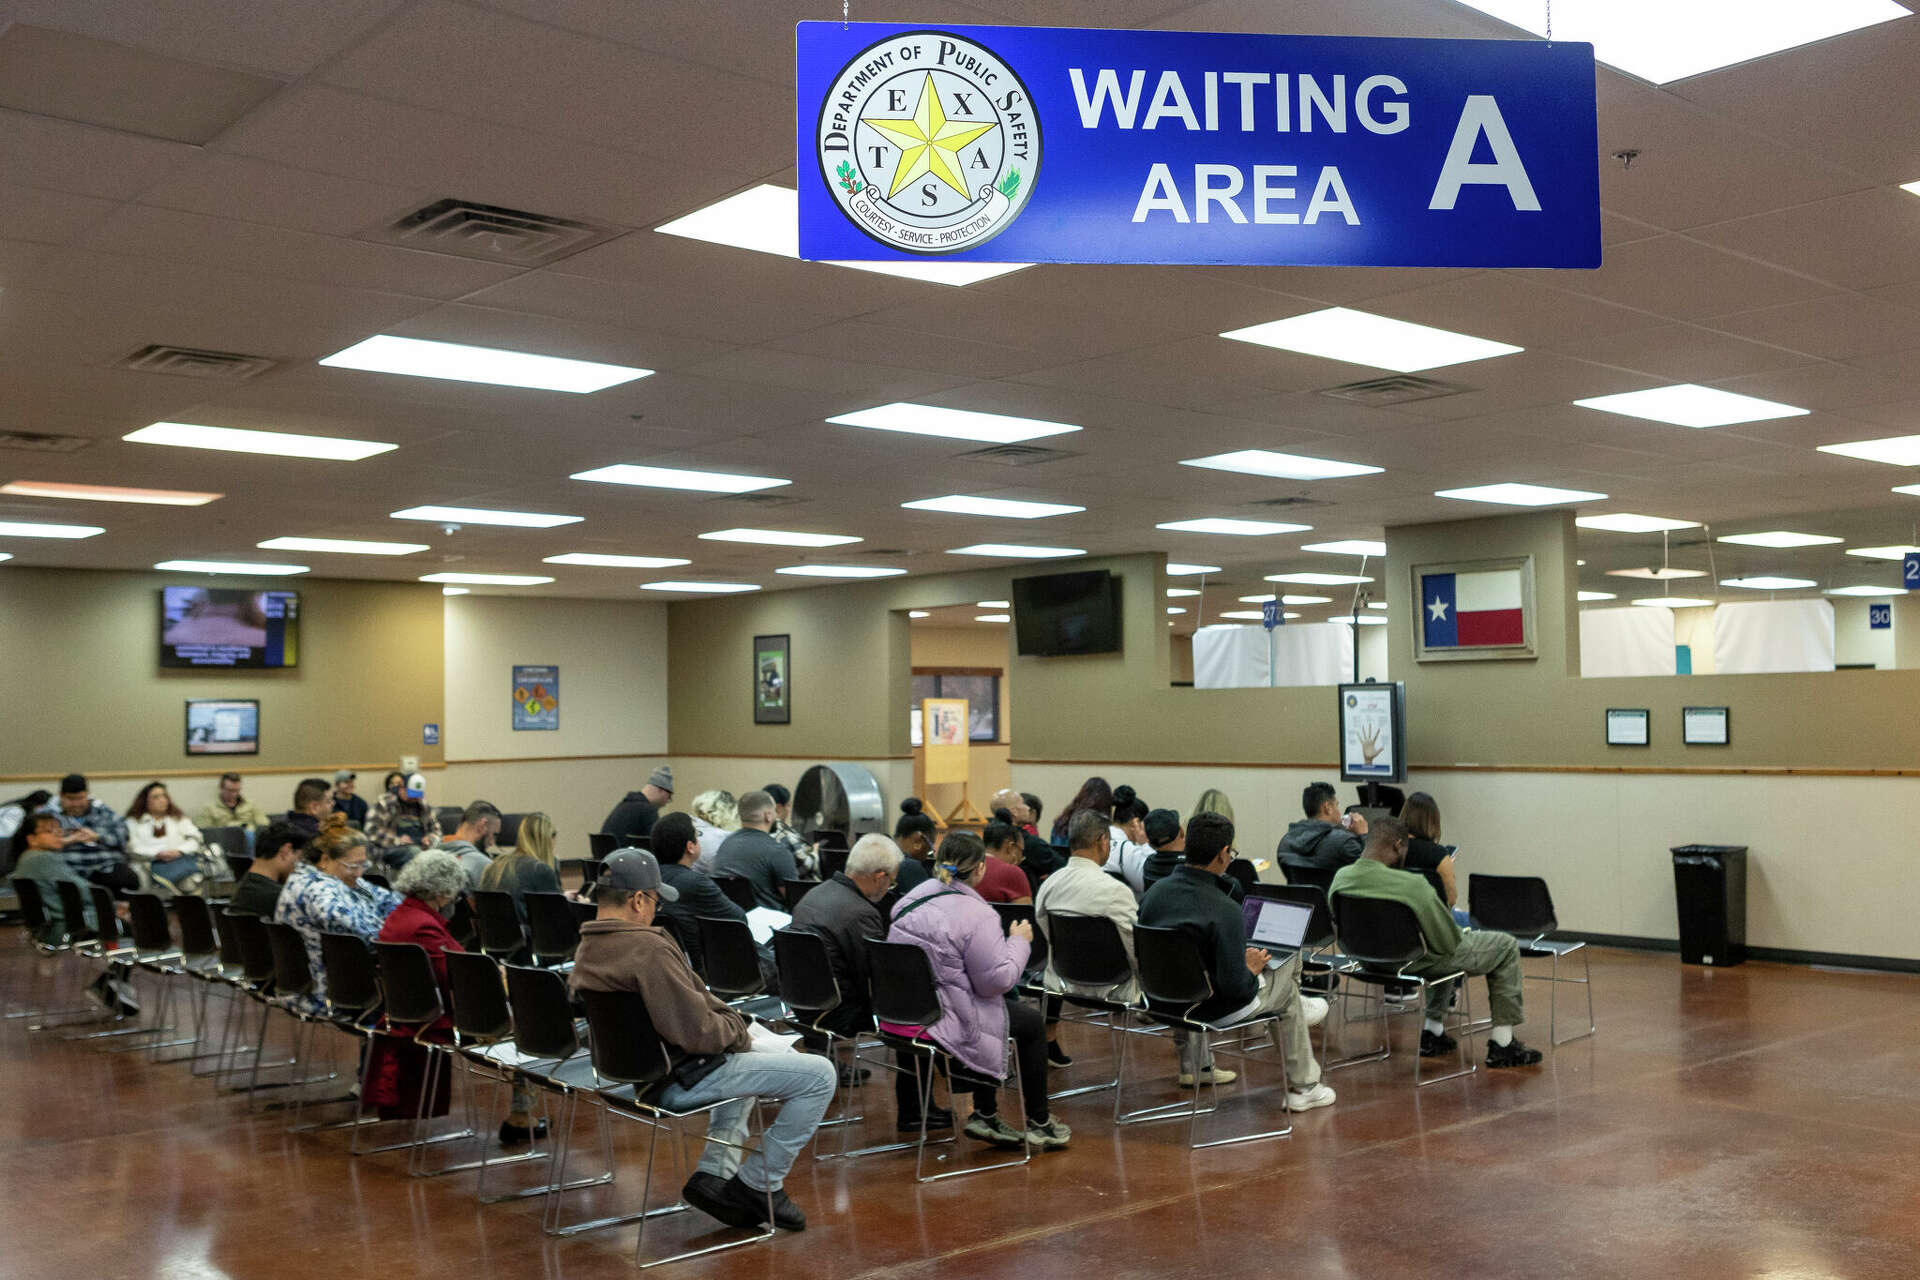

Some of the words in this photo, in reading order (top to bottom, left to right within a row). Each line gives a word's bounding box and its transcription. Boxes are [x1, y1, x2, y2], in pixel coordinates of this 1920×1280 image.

[824, 51, 894, 152] DEPARTMENT
[900, 46, 921, 61] OF
[936, 40, 998, 86] PUBLIC
[995, 90, 1028, 161] SAFETY
[1069, 68, 1410, 135] WAITING
[1428, 95, 1542, 211] A
[855, 200, 895, 234] COURTESY
[898, 229, 933, 244] SERVICE
[940, 213, 991, 244] PROTECTION
[1131, 163, 1360, 225] AREA
[1906, 560, 1920, 580] 2
[1871, 608, 1890, 625] 30
